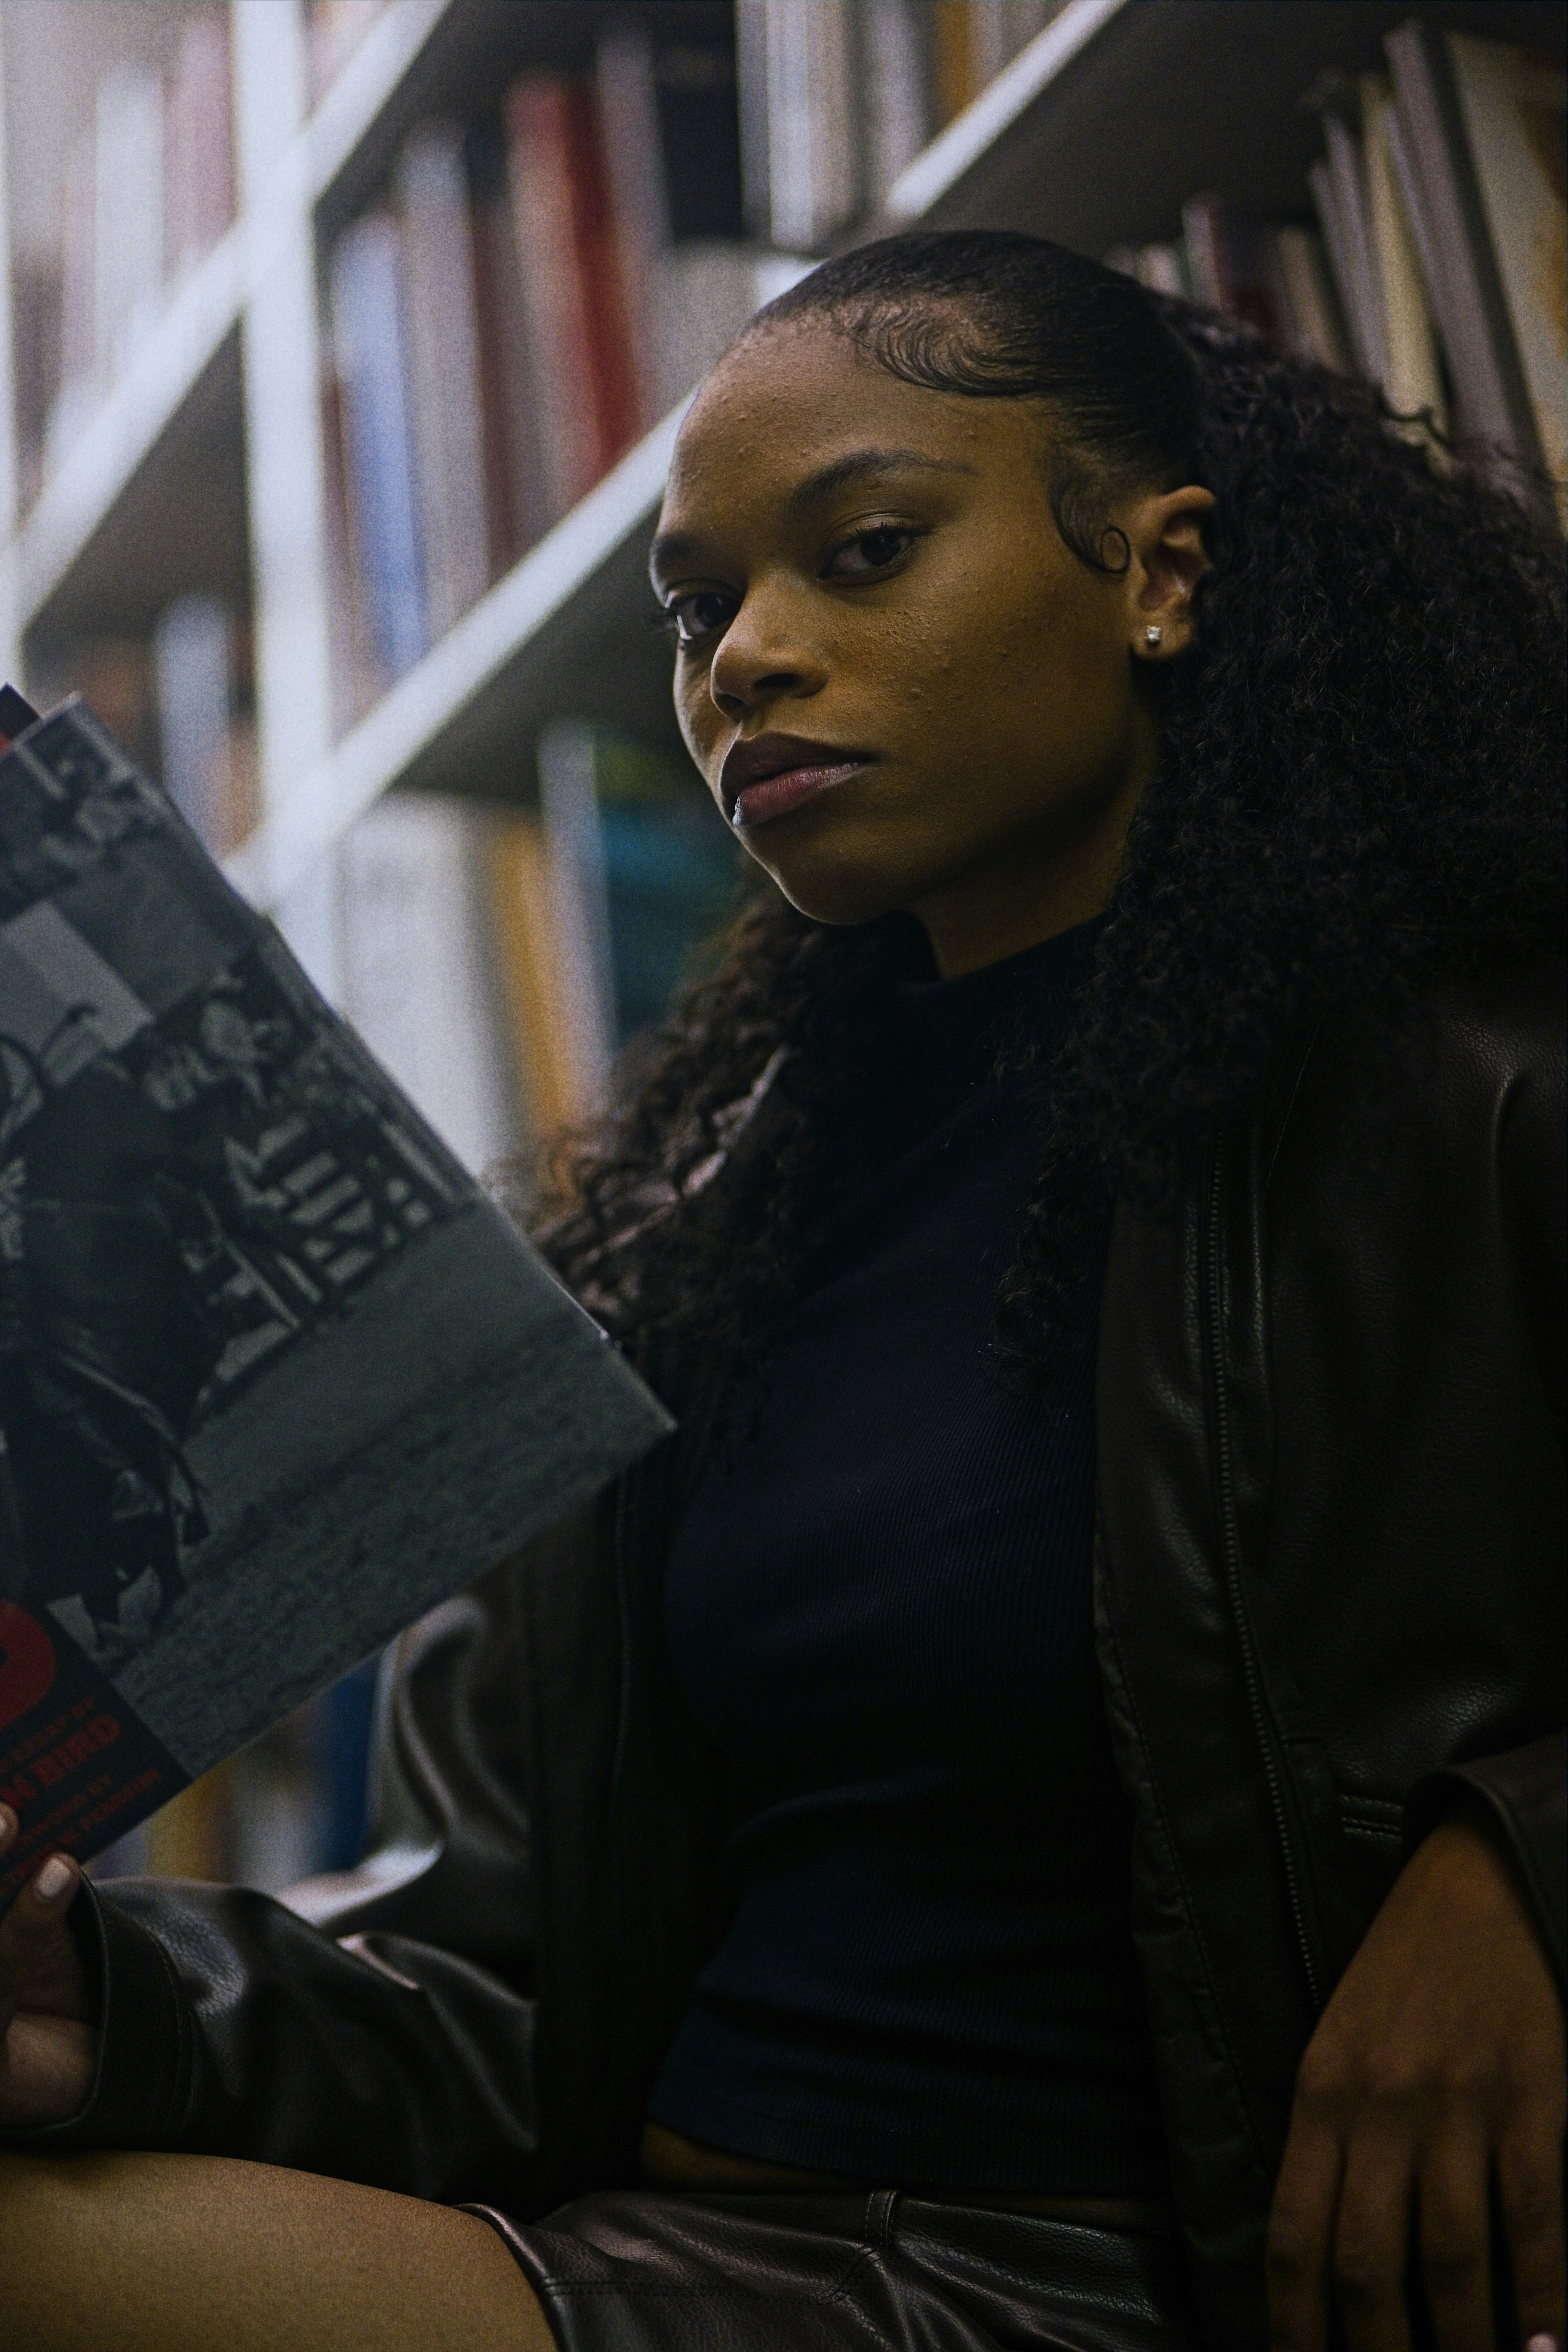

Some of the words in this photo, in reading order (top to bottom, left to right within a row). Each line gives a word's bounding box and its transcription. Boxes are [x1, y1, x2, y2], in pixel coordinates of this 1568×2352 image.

[72, 1697, 94, 1719] BY
[31, 1715, 120, 1786] BIRD
[88, 1774, 112, 1797] BY
